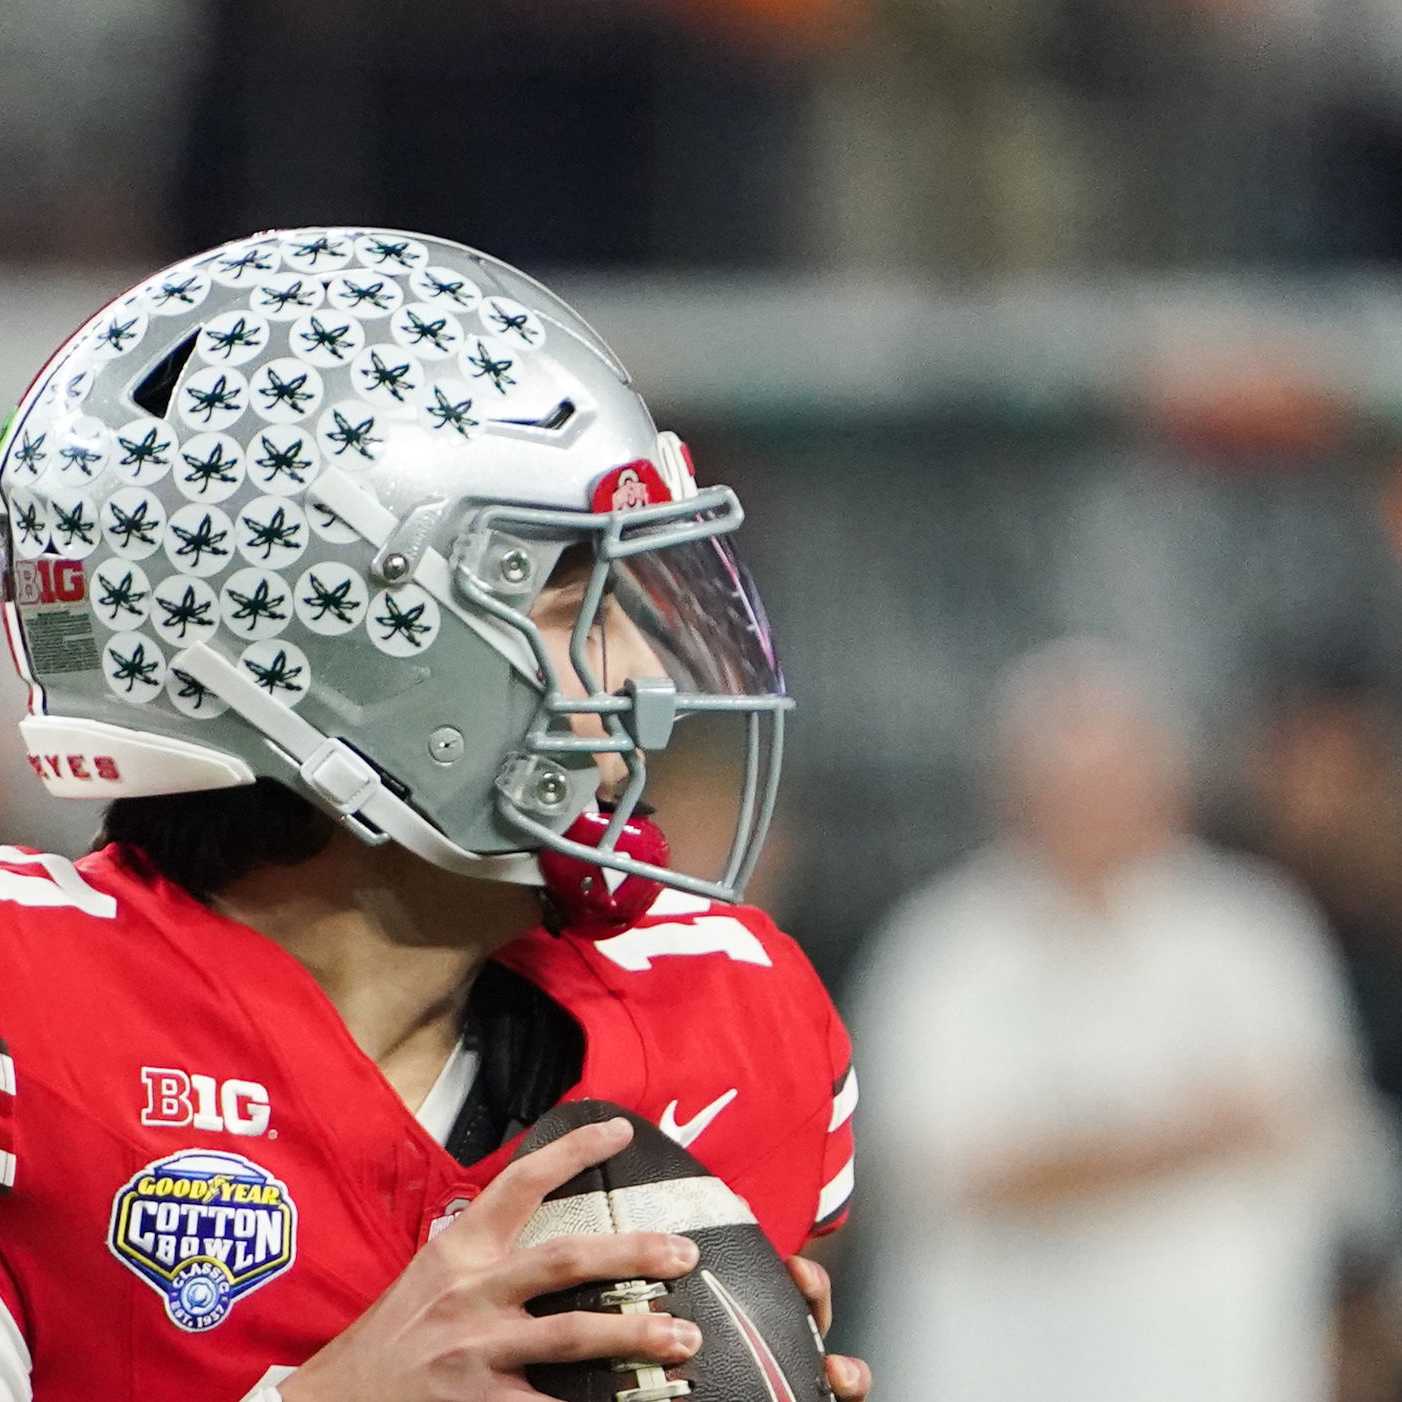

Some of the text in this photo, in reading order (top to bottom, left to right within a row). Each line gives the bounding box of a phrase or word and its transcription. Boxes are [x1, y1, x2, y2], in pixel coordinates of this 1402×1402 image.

[128, 1200, 283, 1264] COTTON
[155, 1235, 255, 1273] BOWL
[172, 1262, 230, 1294] CLASSIC
